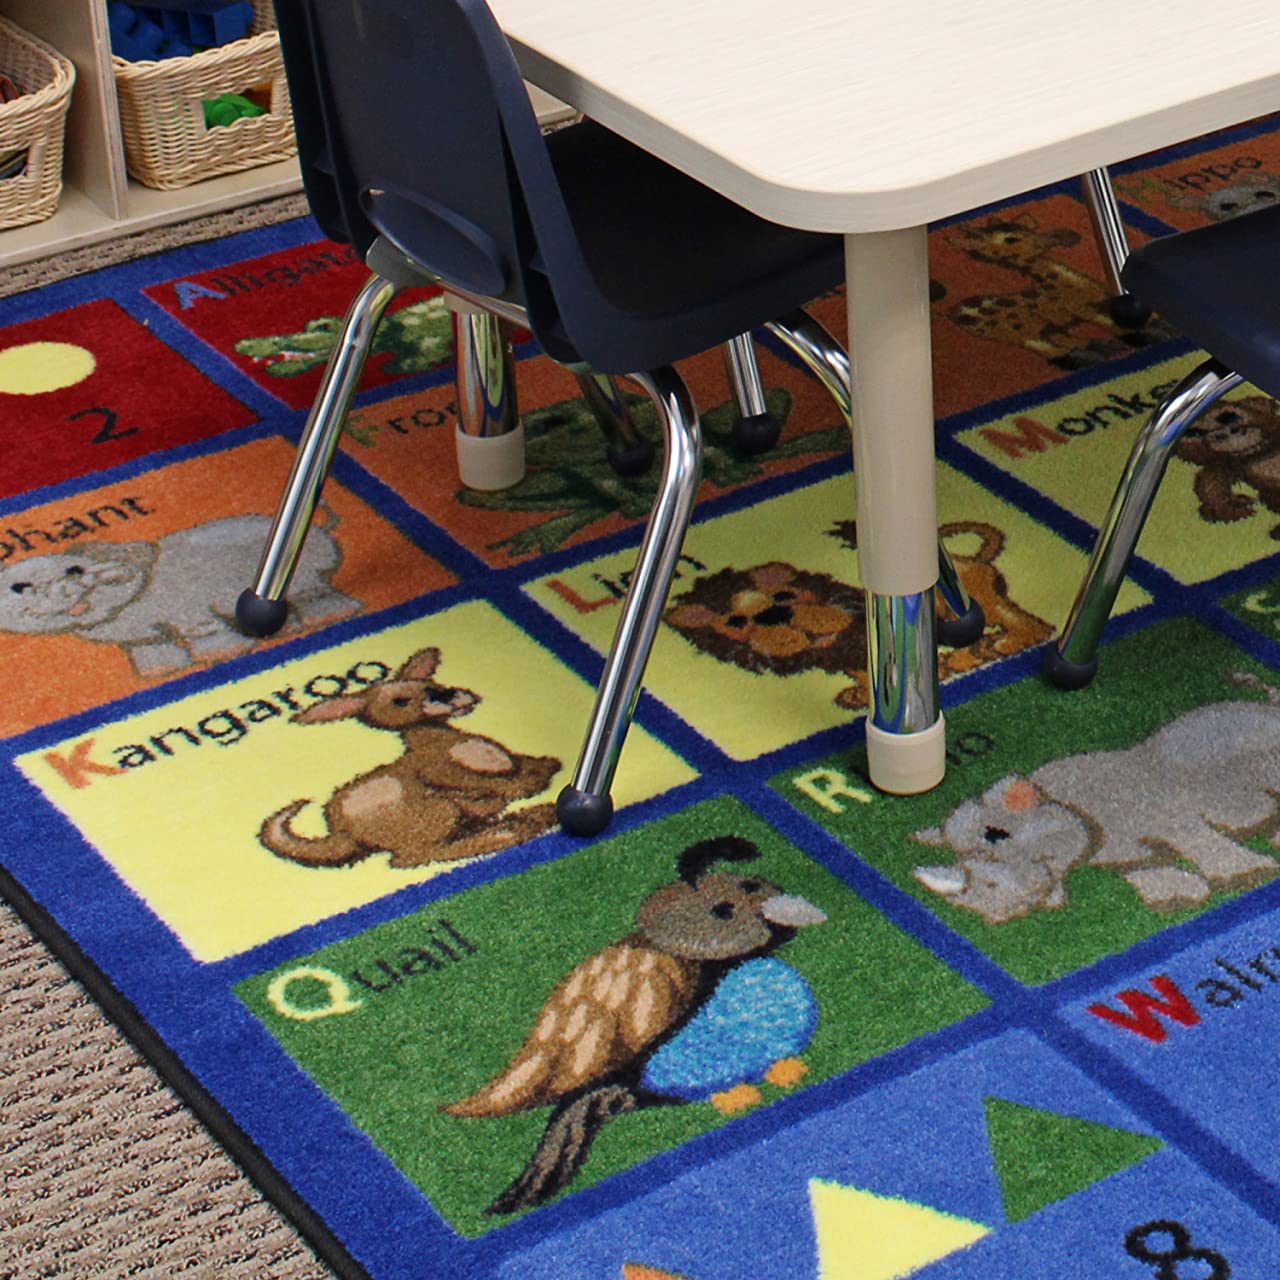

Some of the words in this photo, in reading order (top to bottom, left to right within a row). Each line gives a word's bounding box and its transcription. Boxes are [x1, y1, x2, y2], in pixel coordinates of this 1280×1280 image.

[173, 247, 360, 311] Alligat
[70, 406, 139, 445] 2
[977, 378, 1182, 460] Monke
[545, 553, 708, 615] Lin
[43, 659, 394, 790] Kangaroo
[266, 919, 481, 1021] Quail
[1123, 1219, 1231, 1280] 8
